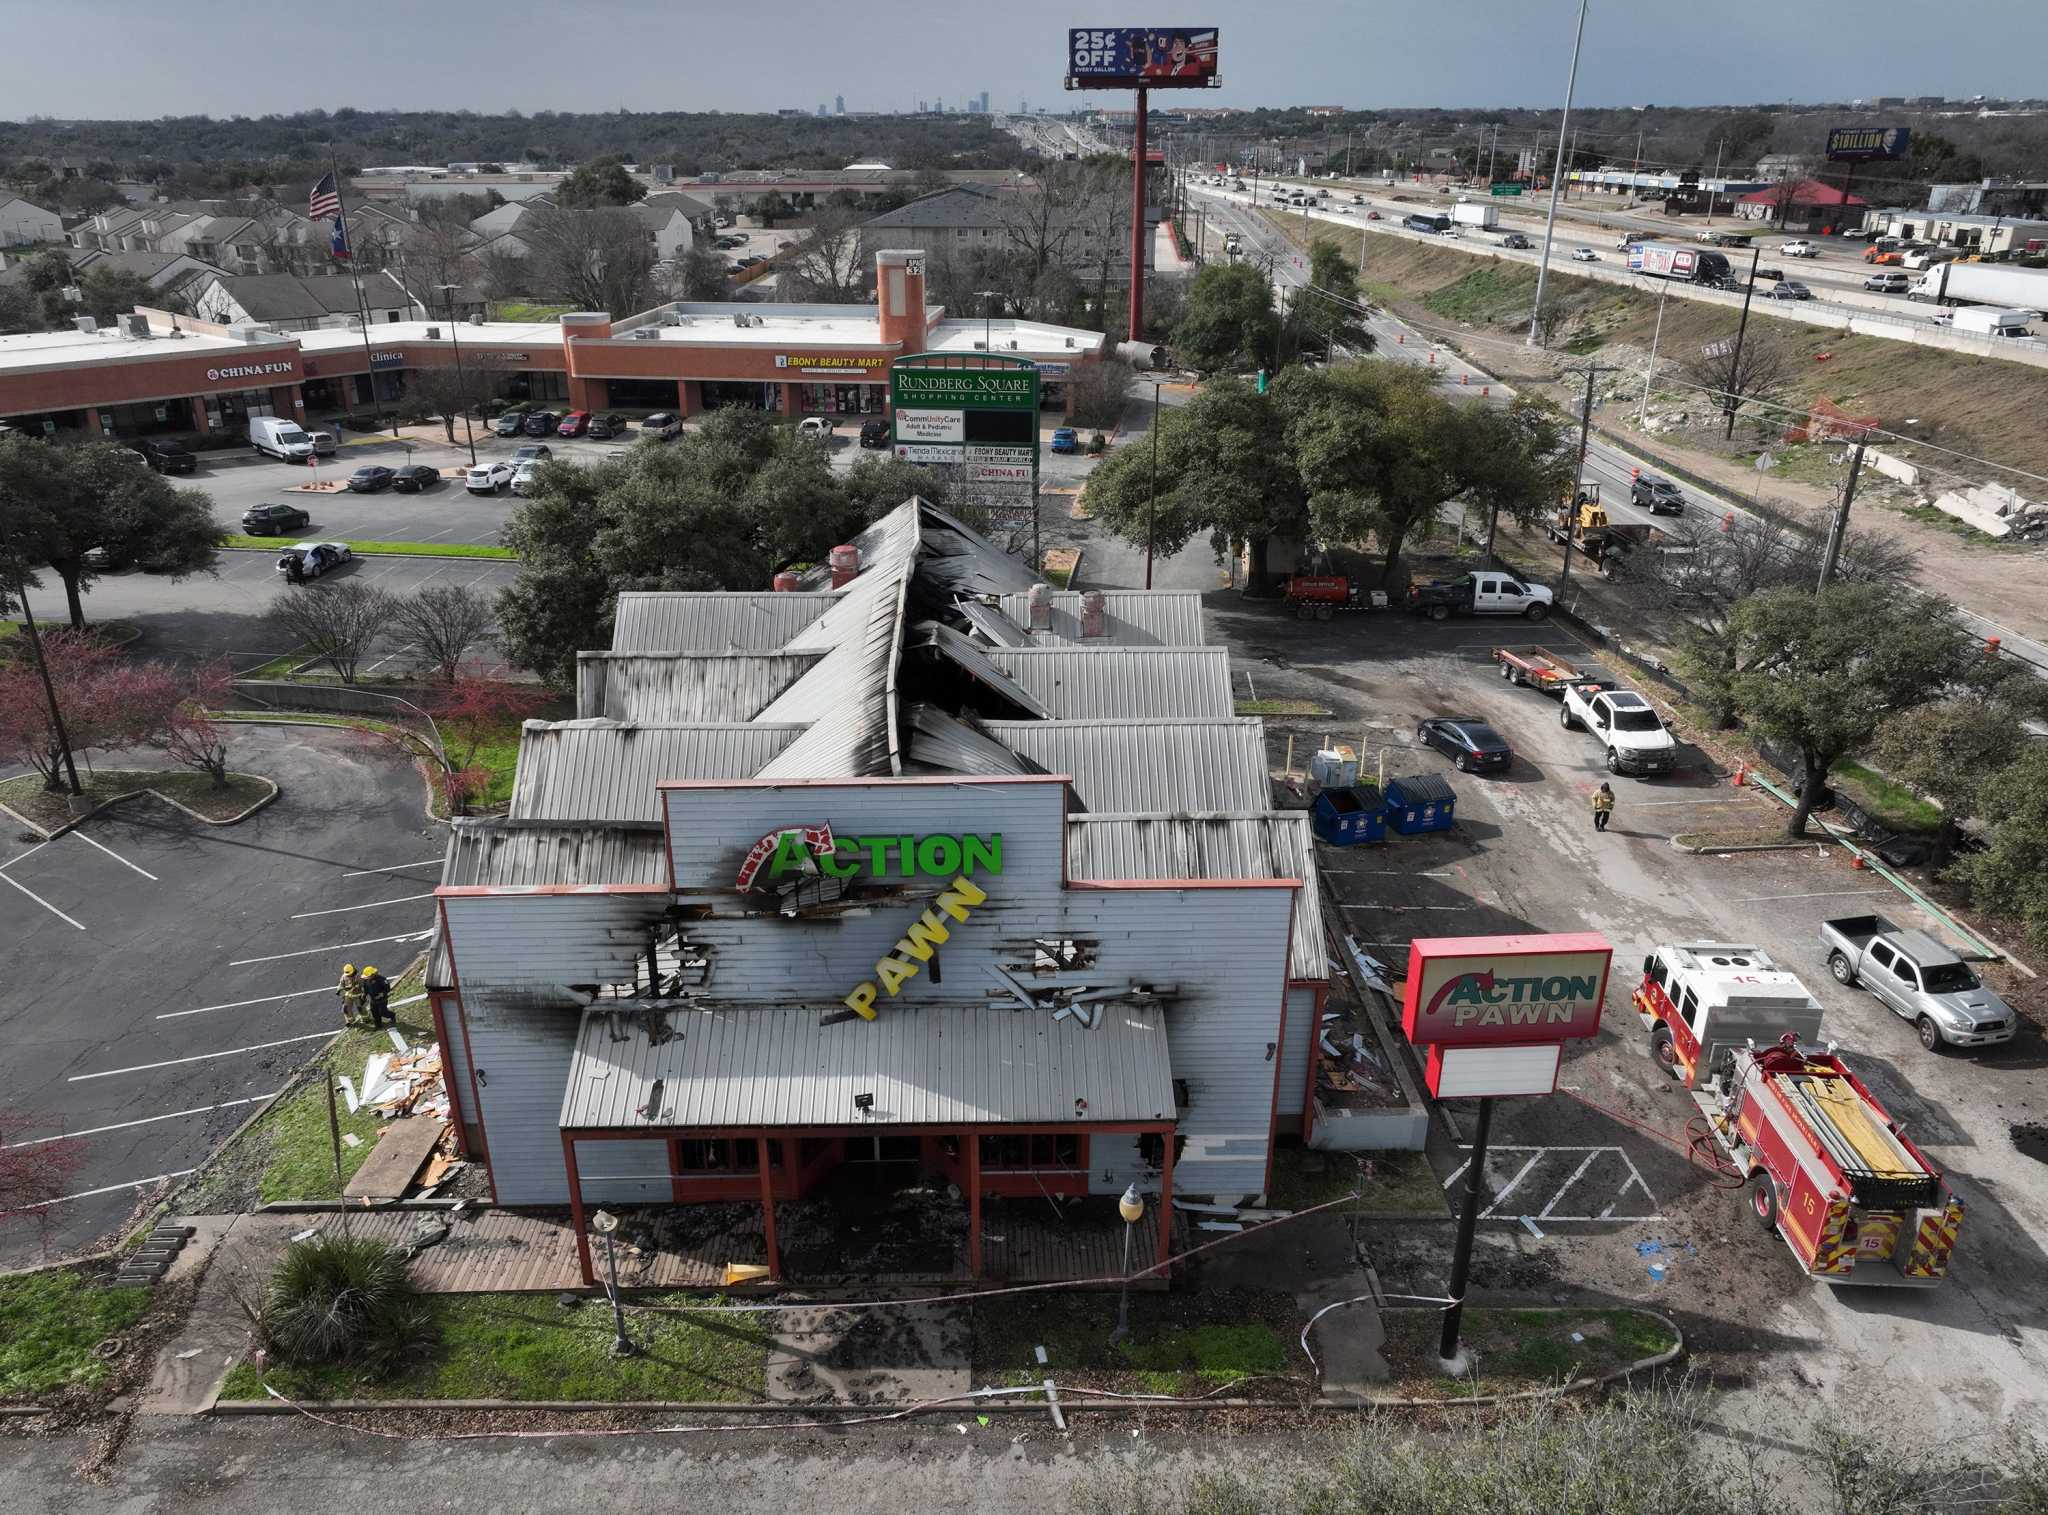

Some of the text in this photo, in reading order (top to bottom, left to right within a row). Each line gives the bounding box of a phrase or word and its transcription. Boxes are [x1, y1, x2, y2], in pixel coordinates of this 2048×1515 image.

[1075, 31, 1116, 50] 25¢
[1075, 50, 1116, 67] OFF
[220, 365, 264, 378] CHINA
[264, 361, 293, 374] FUN
[788, 357, 817, 367] EBONY
[820, 358, 856, 367] BEAUTY
[857, 359, 884, 368] MART
[898, 374, 1030, 393] RUNDBERG SQUARE
[903, 393, 965, 401] SHOPPING
[904, 415, 961, 425] CommUnityCare
[995, 448, 1017, 456] BEAUTY
[982, 469, 1013, 477] CHINA
[768, 832, 1004, 880] ACTION
[845, 875, 988, 1022] PAWN
[1447, 975, 1597, 1006] ACTION
[1454, 1002, 1576, 1027] PAWN
[1803, 1191, 1816, 1216] 15
[1863, 1238, 1881, 1249] 15
